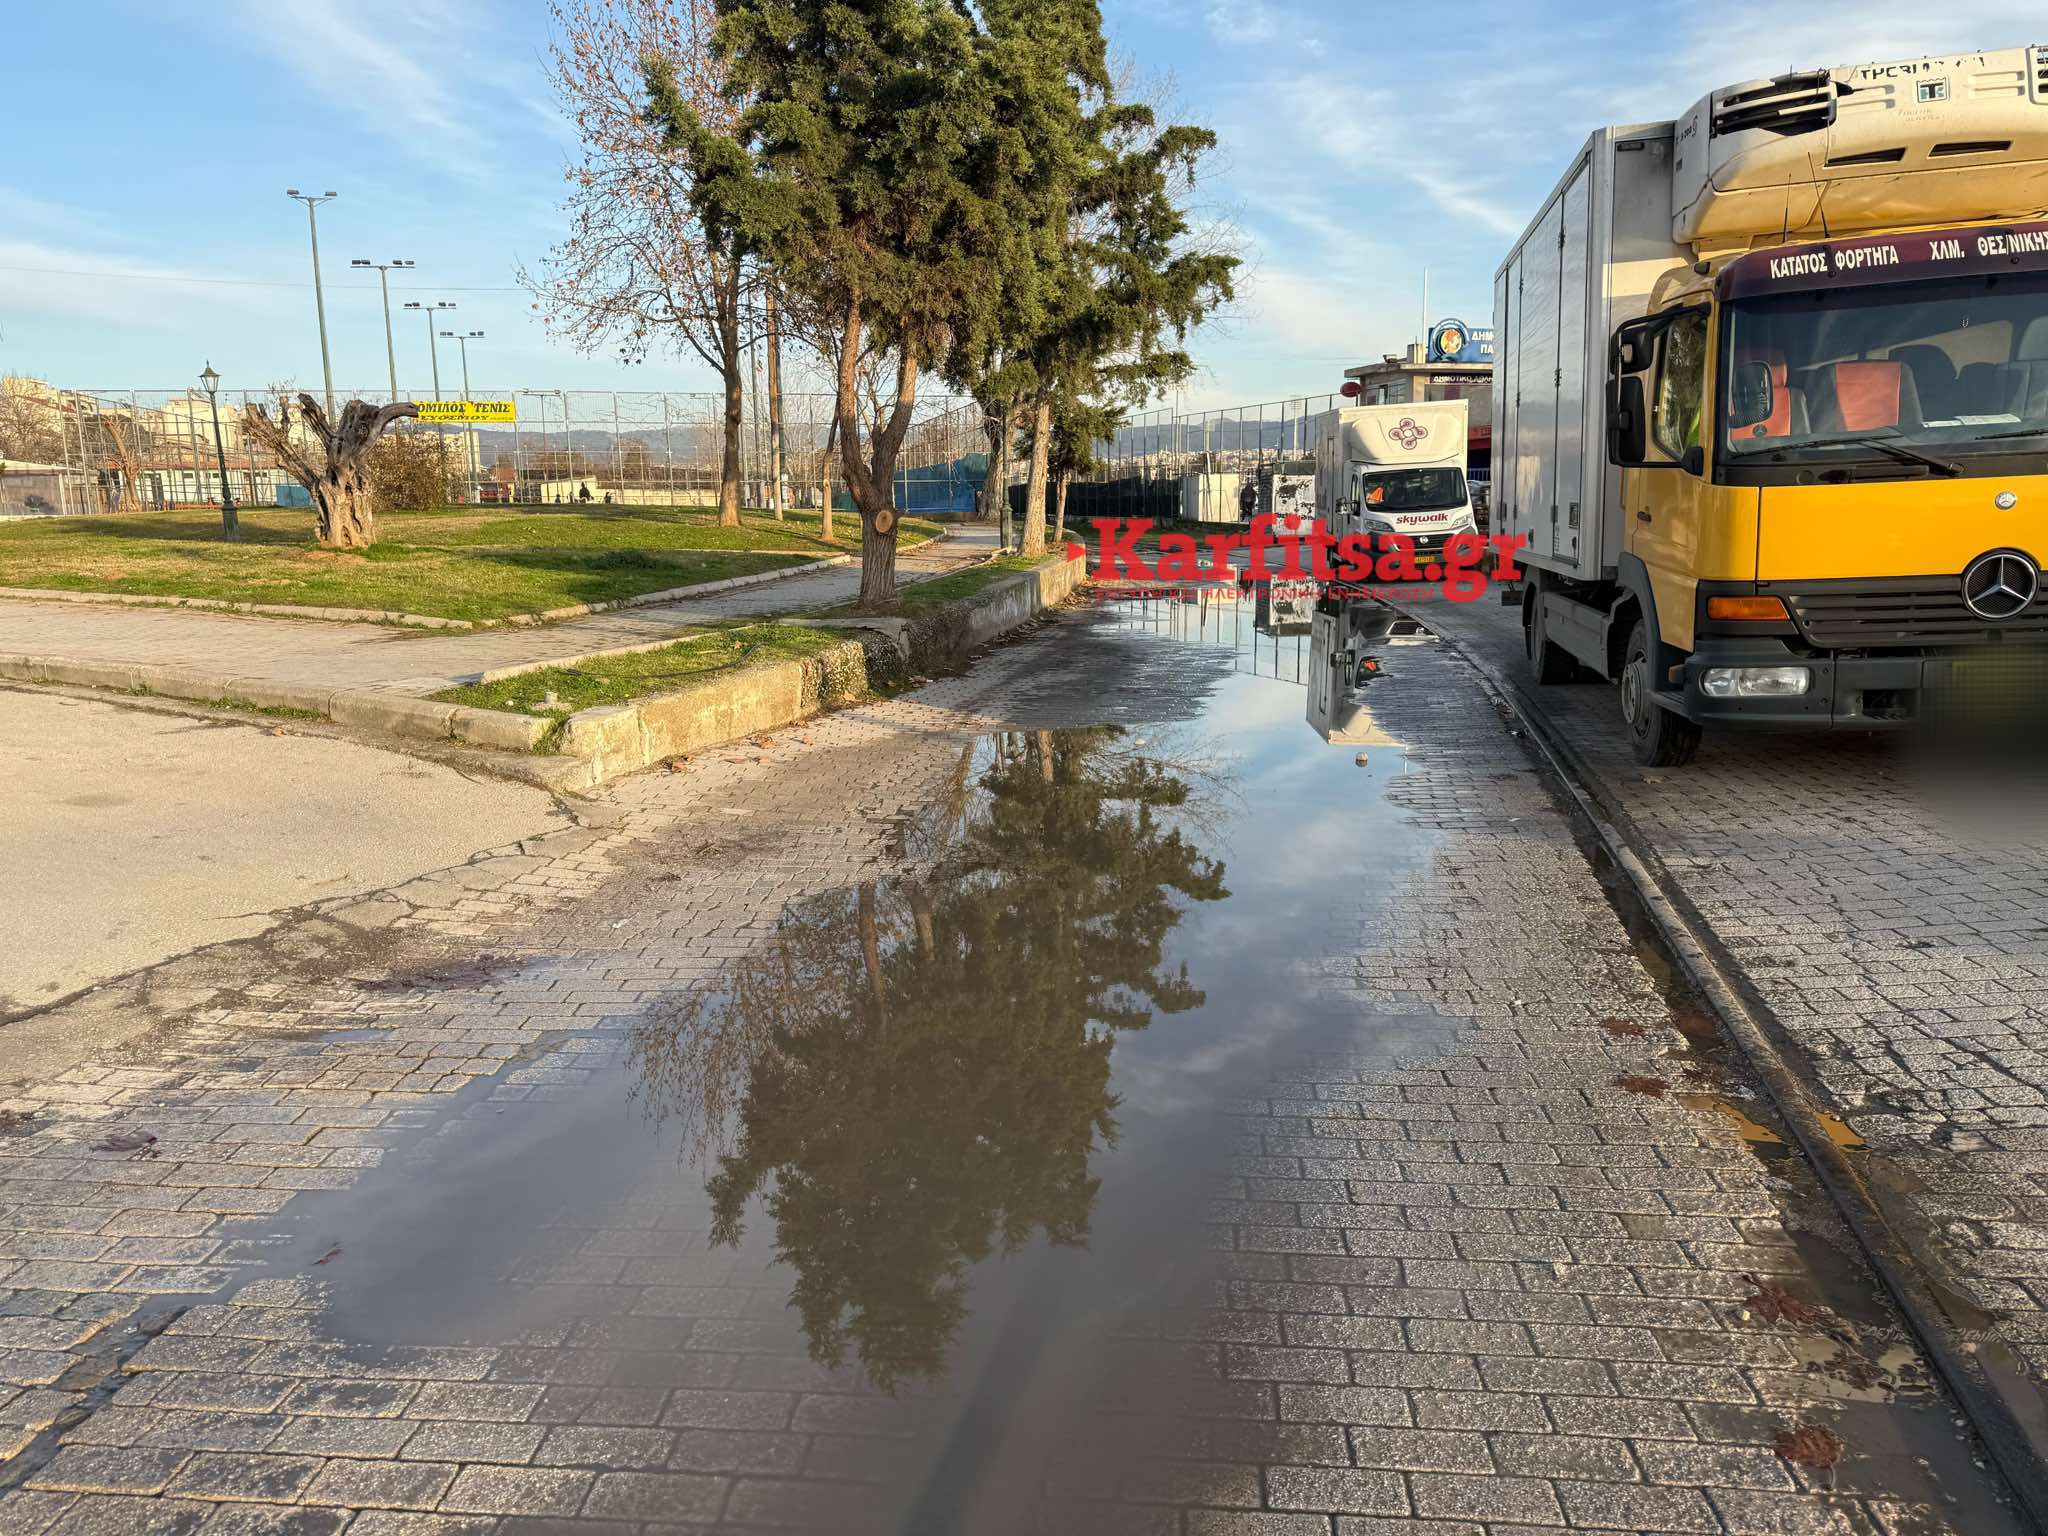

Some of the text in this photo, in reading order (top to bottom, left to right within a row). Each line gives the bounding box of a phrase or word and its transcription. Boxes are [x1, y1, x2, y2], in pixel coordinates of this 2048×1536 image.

[1770, 252, 1828, 279] ΚΑΤΑΤΟΣ
[1835, 245, 1899, 270] ΦΟΡΤΗΓΑ
[1433, 375, 1472, 383] ΔΗΜΟΤΙΚΟ
[418, 403, 510, 413] ΟΜΙΛΟΣ ΤΕΝΙΣ
[1396, 512, 1449, 526] skywalk
